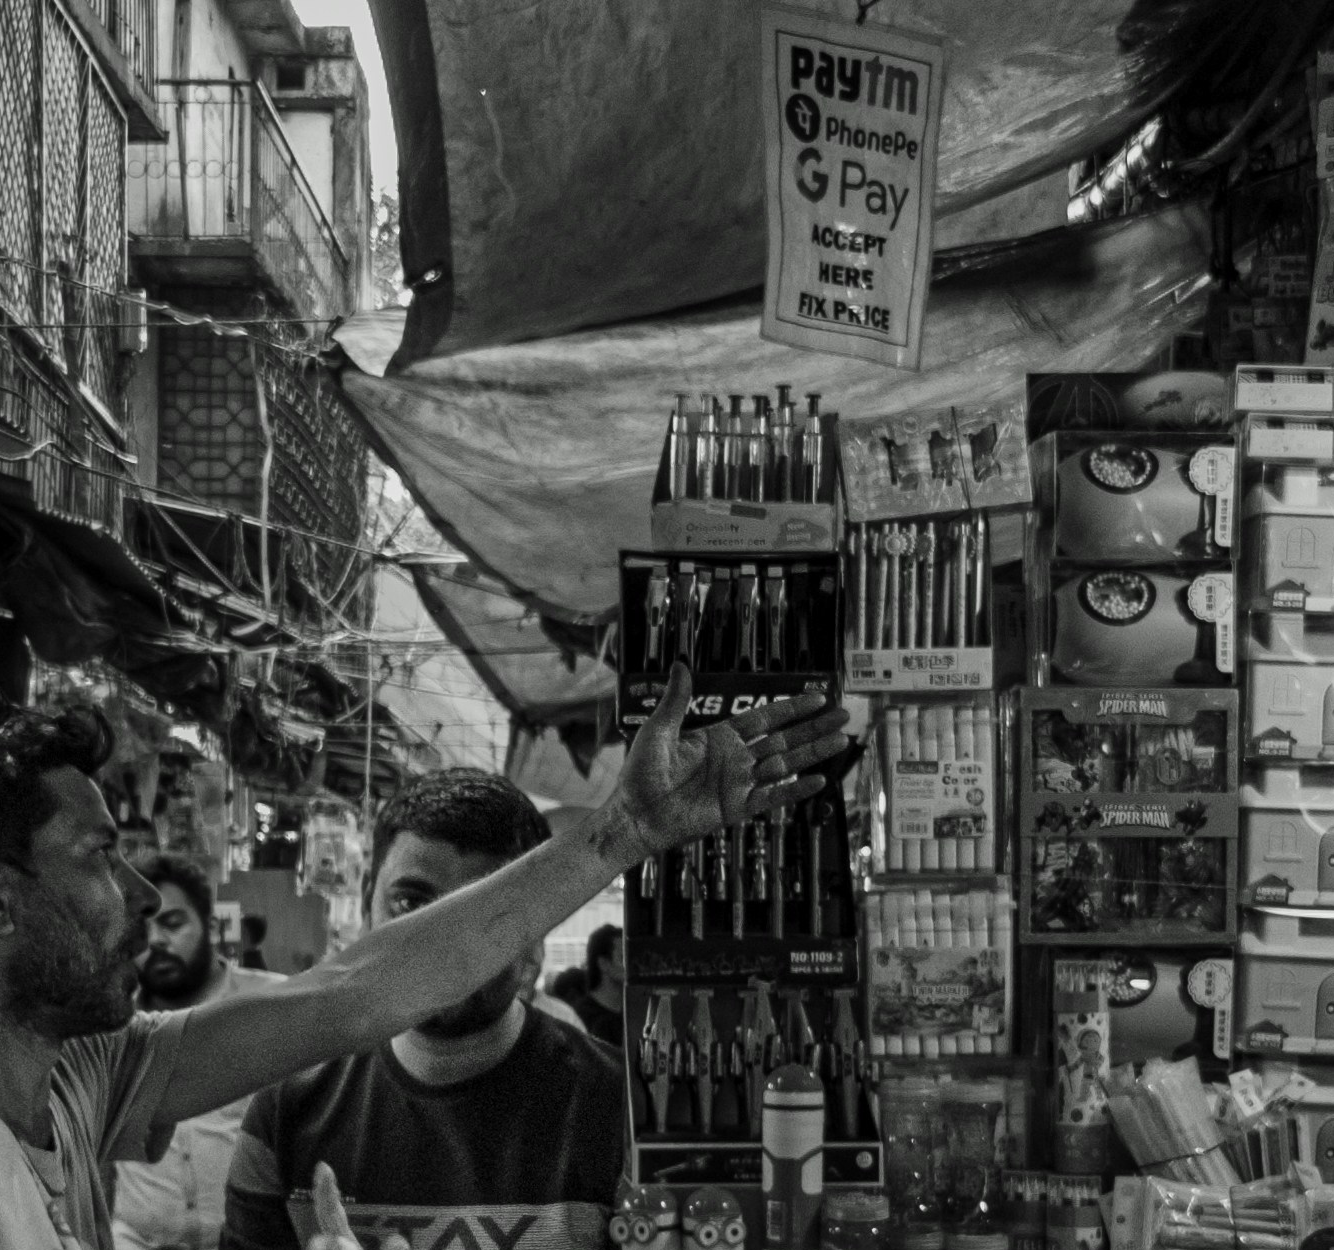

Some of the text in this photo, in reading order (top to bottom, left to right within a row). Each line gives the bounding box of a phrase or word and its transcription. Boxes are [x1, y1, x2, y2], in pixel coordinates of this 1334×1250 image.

[825, 117, 918, 160] PhonePe
[794, 147, 910, 231] G Pay
[811, 223, 887, 257] ACCEPT
[818, 262, 874, 291] HERE
[797, 292, 890, 331] FIX PRICE
